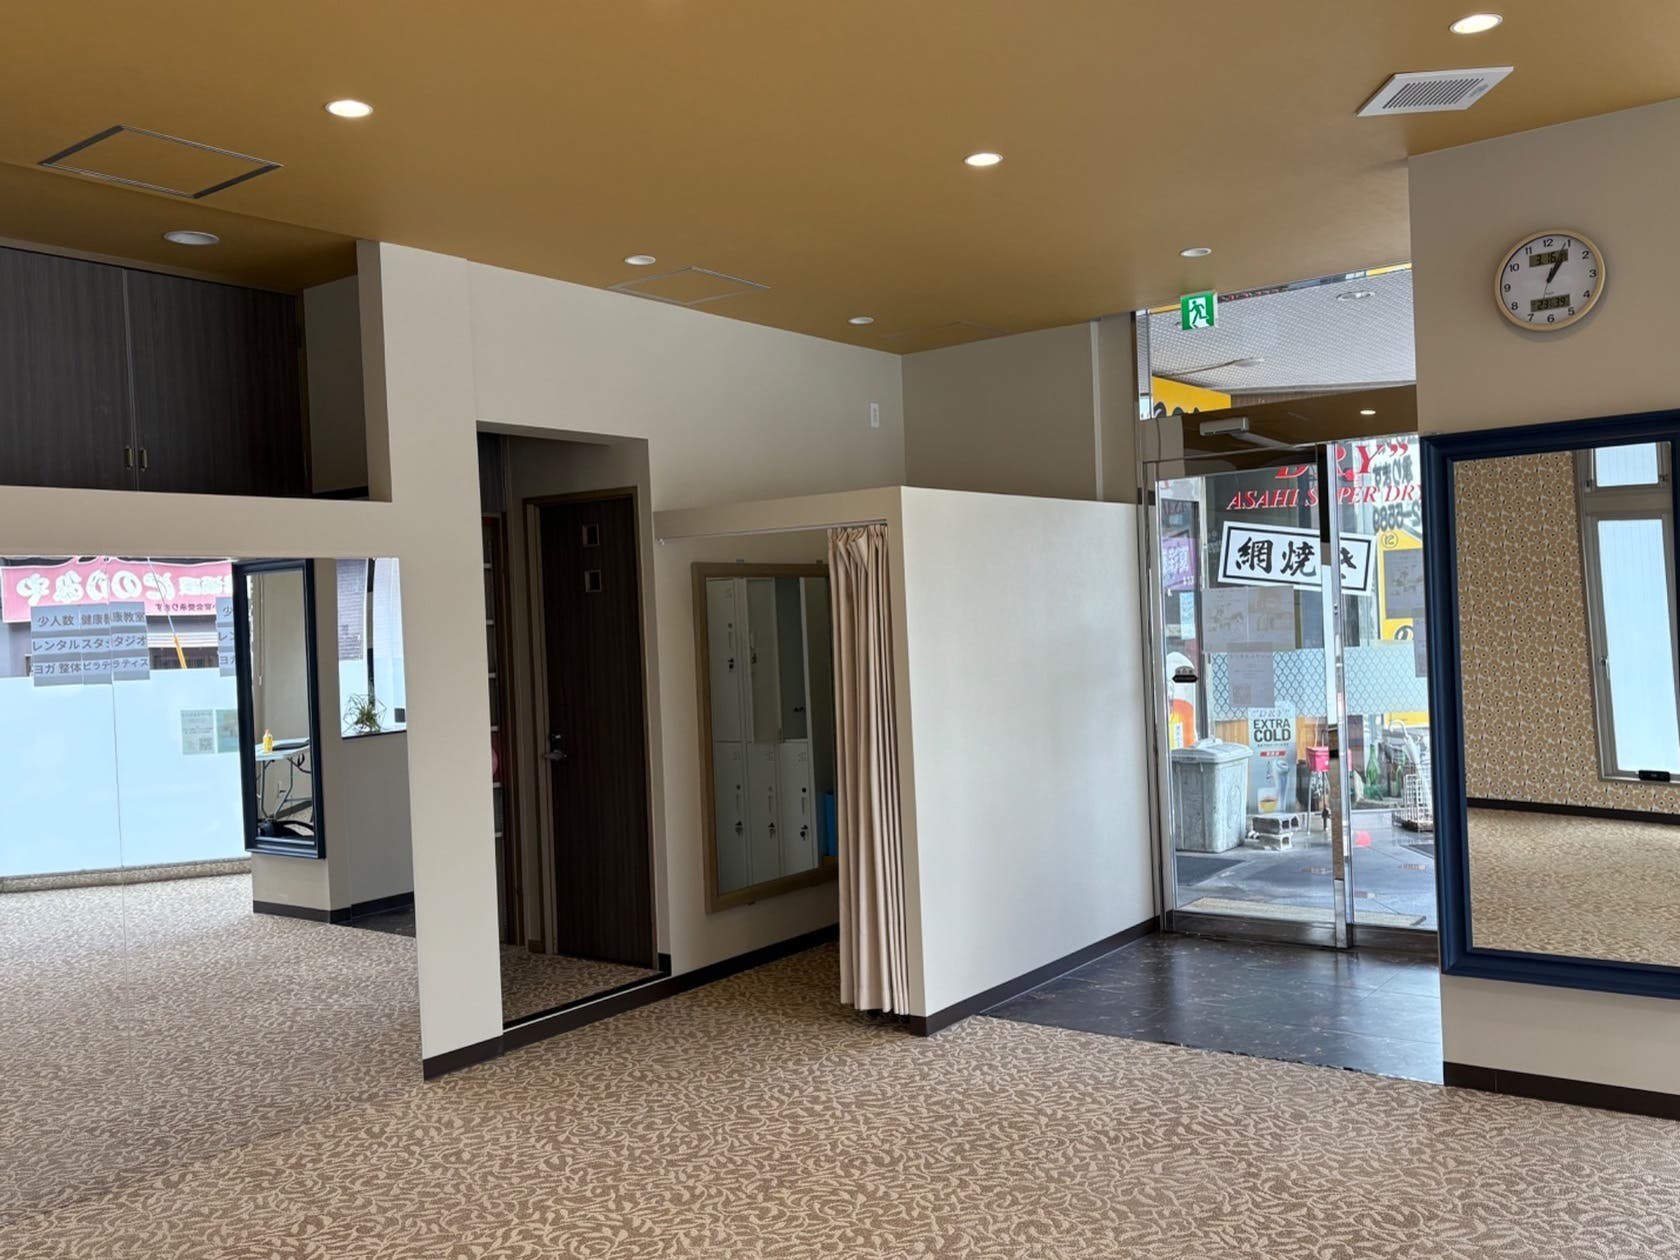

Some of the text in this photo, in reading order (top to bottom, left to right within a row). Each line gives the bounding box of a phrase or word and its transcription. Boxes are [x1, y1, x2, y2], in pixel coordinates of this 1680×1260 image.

[1543, 239, 1553, 248] 12
[1567, 239, 1571, 247] 1
[1525, 247, 1532, 255] 11
[1582, 251, 1590, 260] 2
[1509, 263, 1520, 272] 10
[1589, 269, 1597, 278] 3
[1503, 284, 1511, 292] 9
[1583, 290, 1590, 298] 4
[1511, 302, 1519, 310] 8
[1568, 307, 1575, 316] 5
[1527, 313, 1534, 322] 7
[1547, 314, 1555, 323] 6
[1226, 488, 1299, 510] ASAHI
[1304, 484, 1378, 508] SPER
[38, 614, 75, 628] 少人数
[1253, 719, 1291, 730] EXTRA
[1253, 729, 1292, 743] COLD
